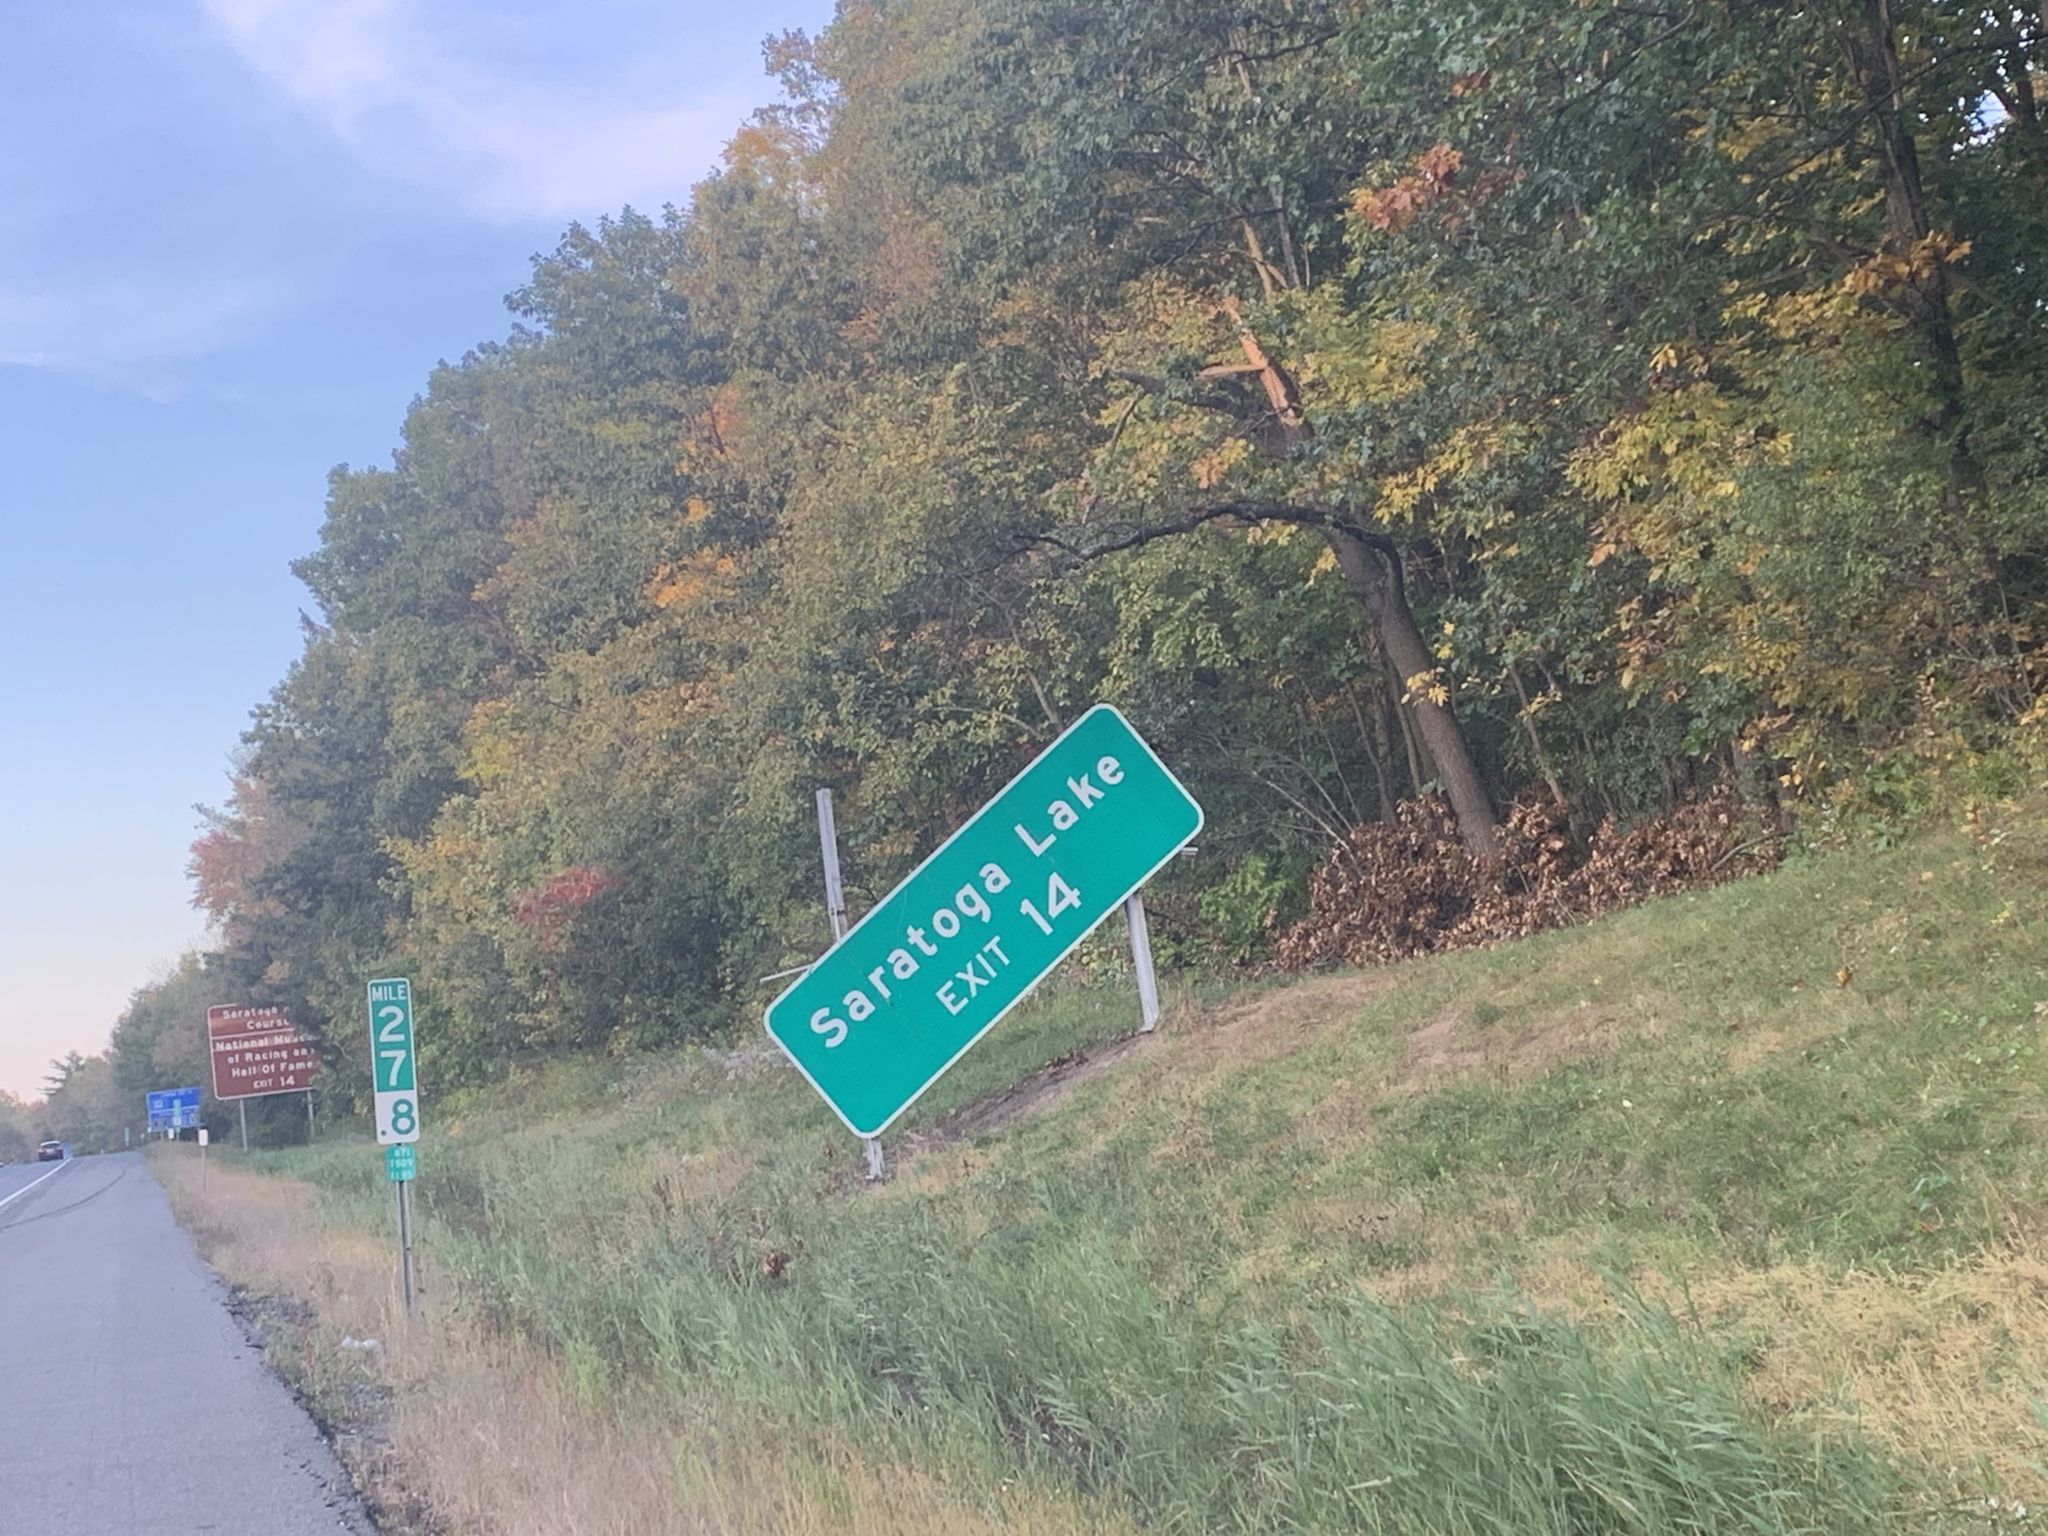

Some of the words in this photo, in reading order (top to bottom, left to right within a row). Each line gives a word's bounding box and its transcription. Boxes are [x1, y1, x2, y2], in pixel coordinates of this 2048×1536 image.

[809, 861, 1011, 1048] Saratoga
[1014, 755, 1125, 857] Lake
[935, 935, 1011, 1016] EXIT
[1020, 871, 1083, 936] 14
[371, 984, 407, 1002] MILE
[222, 1006, 278, 1020] Saratoga
[215, 1037, 269, 1051] National
[273, 1032, 321, 1046] Museu
[227, 1053, 239, 1064] of
[245, 1050, 288, 1062] Racing
[232, 1065, 257, 1078] Hall
[262, 1062, 275, 1074] Of
[280, 1060, 313, 1072] Fame
[253, 1078, 273, 1089] EXIT
[280, 1075, 295, 1087] 14
